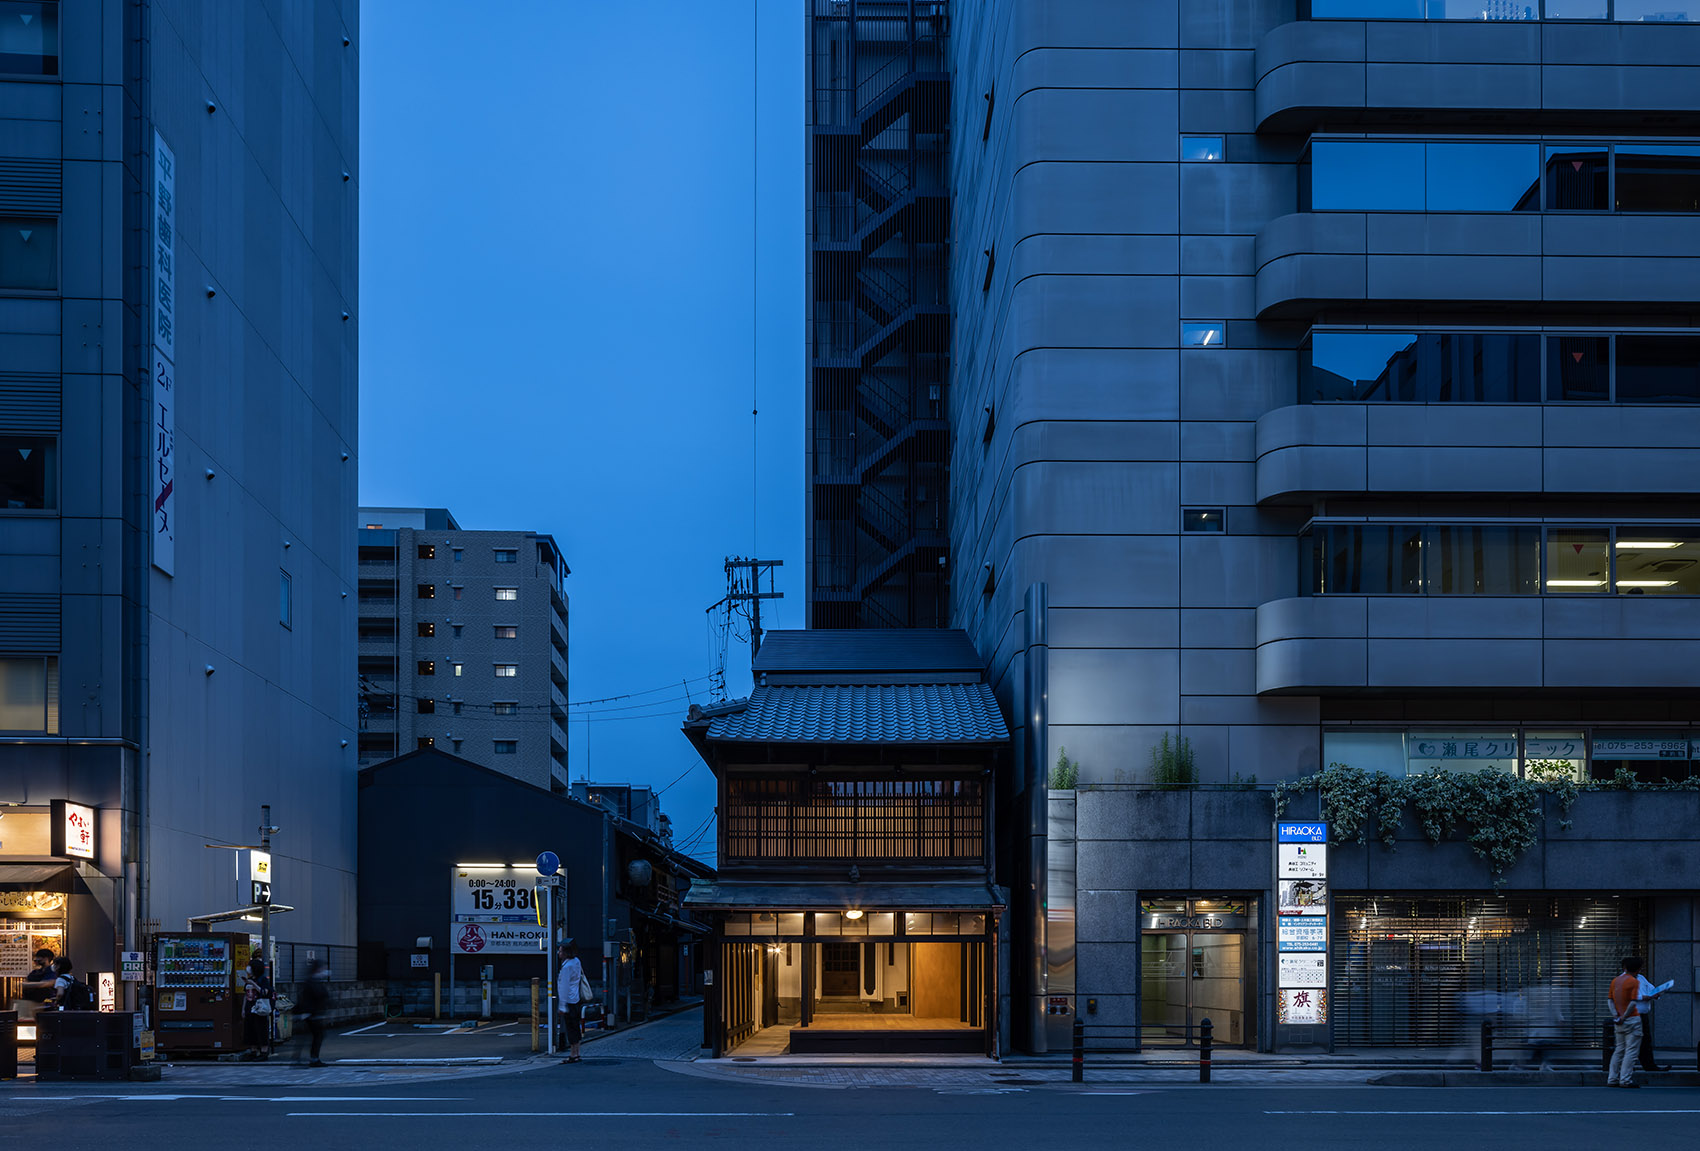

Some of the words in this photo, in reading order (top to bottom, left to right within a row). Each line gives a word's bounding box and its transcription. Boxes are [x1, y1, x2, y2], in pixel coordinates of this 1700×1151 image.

[158, 147, 172, 345] 平野歯科医院
[158, 362, 172, 391] 2F
[1442, 742, 1575, 756] 瀬尾クリニック
[69, 812, 89, 827] やよい
[80, 829, 90, 845] 軒
[1281, 826, 1322, 836] HIRAOKA
[254, 885, 262, 905] P
[1293, 990, 1312, 1008] 旗
